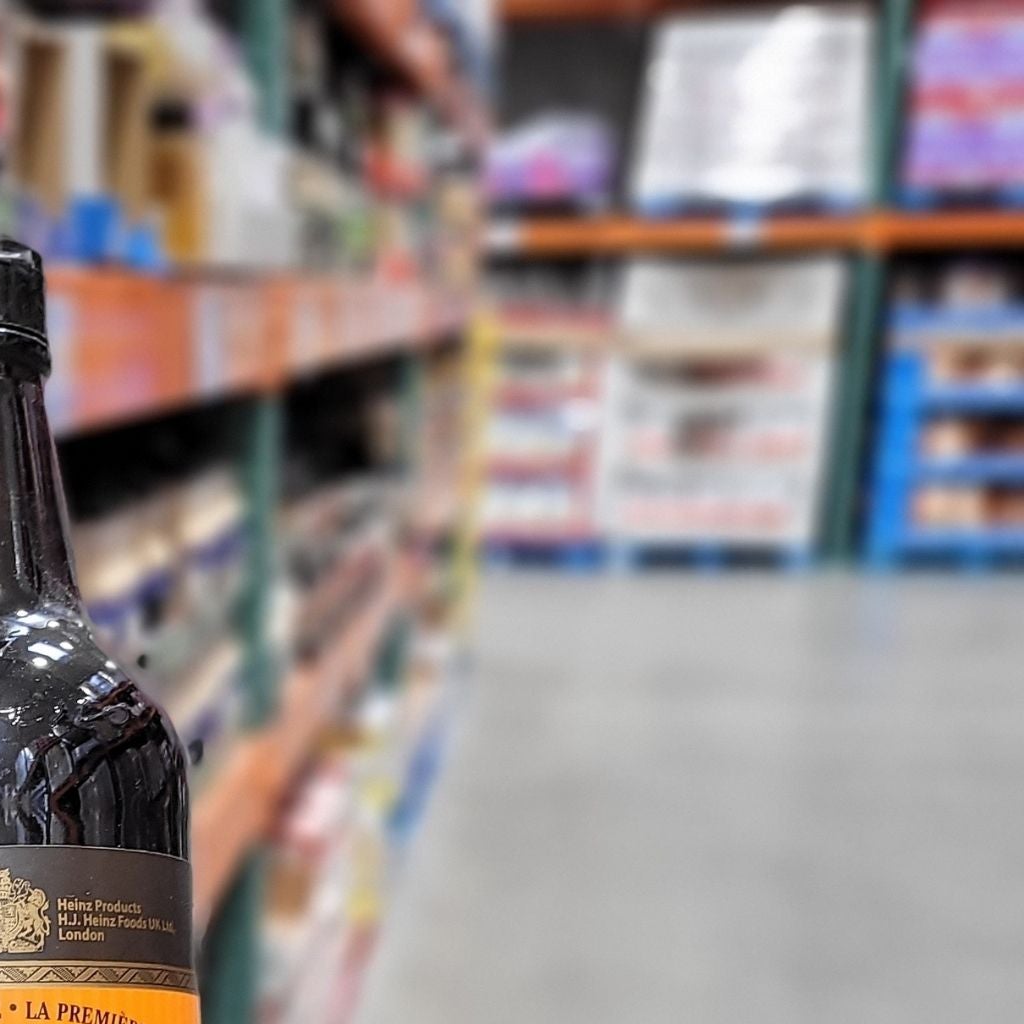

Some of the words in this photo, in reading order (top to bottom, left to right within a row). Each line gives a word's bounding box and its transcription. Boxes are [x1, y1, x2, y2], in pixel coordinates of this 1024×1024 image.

[57, 898, 93, 911] Heinz
[95, 899, 142, 914] Products
[58, 913, 81, 926] H.J.
[83, 913, 116, 928] Heinz
[117, 915, 147, 930] Foods
[148, 918, 161, 931] UK
[58, 927, 105, 941] London
[26, 1001, 50, 1020] LA
